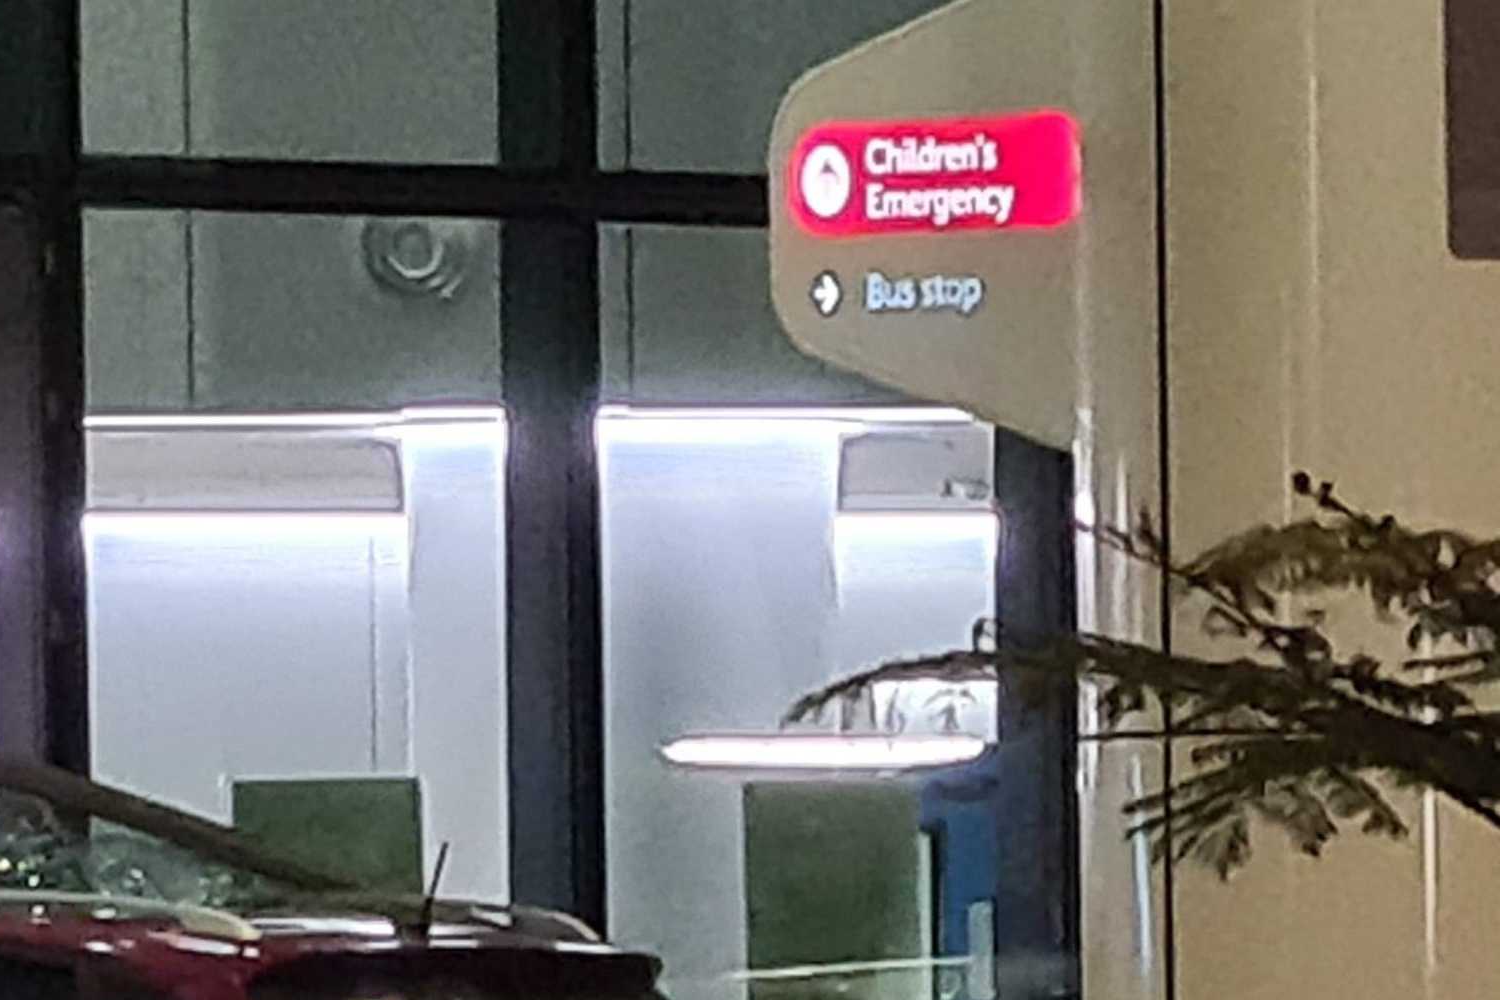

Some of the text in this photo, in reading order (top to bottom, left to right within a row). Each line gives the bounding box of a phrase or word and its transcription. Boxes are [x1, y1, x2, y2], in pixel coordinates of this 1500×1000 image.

[863, 133, 998, 175] Children's
[864, 183, 1015, 226] Emergency
[866, 271, 983, 313] Bus stop
